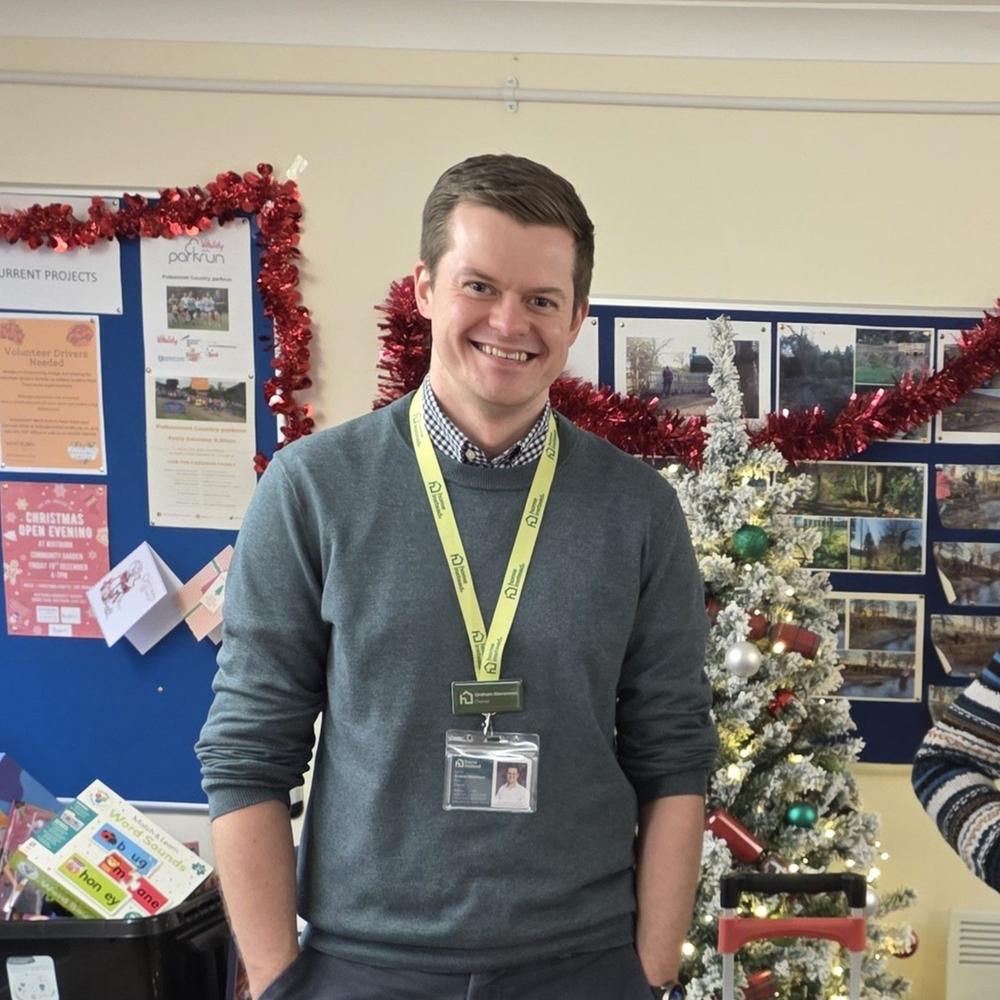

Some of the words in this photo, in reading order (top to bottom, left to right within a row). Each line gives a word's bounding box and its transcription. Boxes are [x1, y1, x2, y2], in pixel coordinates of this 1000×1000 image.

[168, 246, 225, 265] parkrun
[0, 268, 40, 280] URRENT
[45, 270, 97, 282] PROJECTS
[4, 347, 51, 357] Volunteer
[53, 349, 88, 359] Drivers
[30, 358, 65, 367] Needed
[26, 511, 84, 525] CHRISTMAS
[18, 524, 46, 537] OPEN
[48, 525, 93, 539] EVENING
[133, 815, 154, 837] Match
[110, 809, 142, 838] Word
[144, 834, 187, 872] Sounds
[116, 840, 127, 851] b
[131, 852, 148, 869] ug
[80, 870, 103, 892] hon
[104, 892, 119, 907] ey
[112, 866, 126, 879] m
[137, 886, 160, 909] ane
